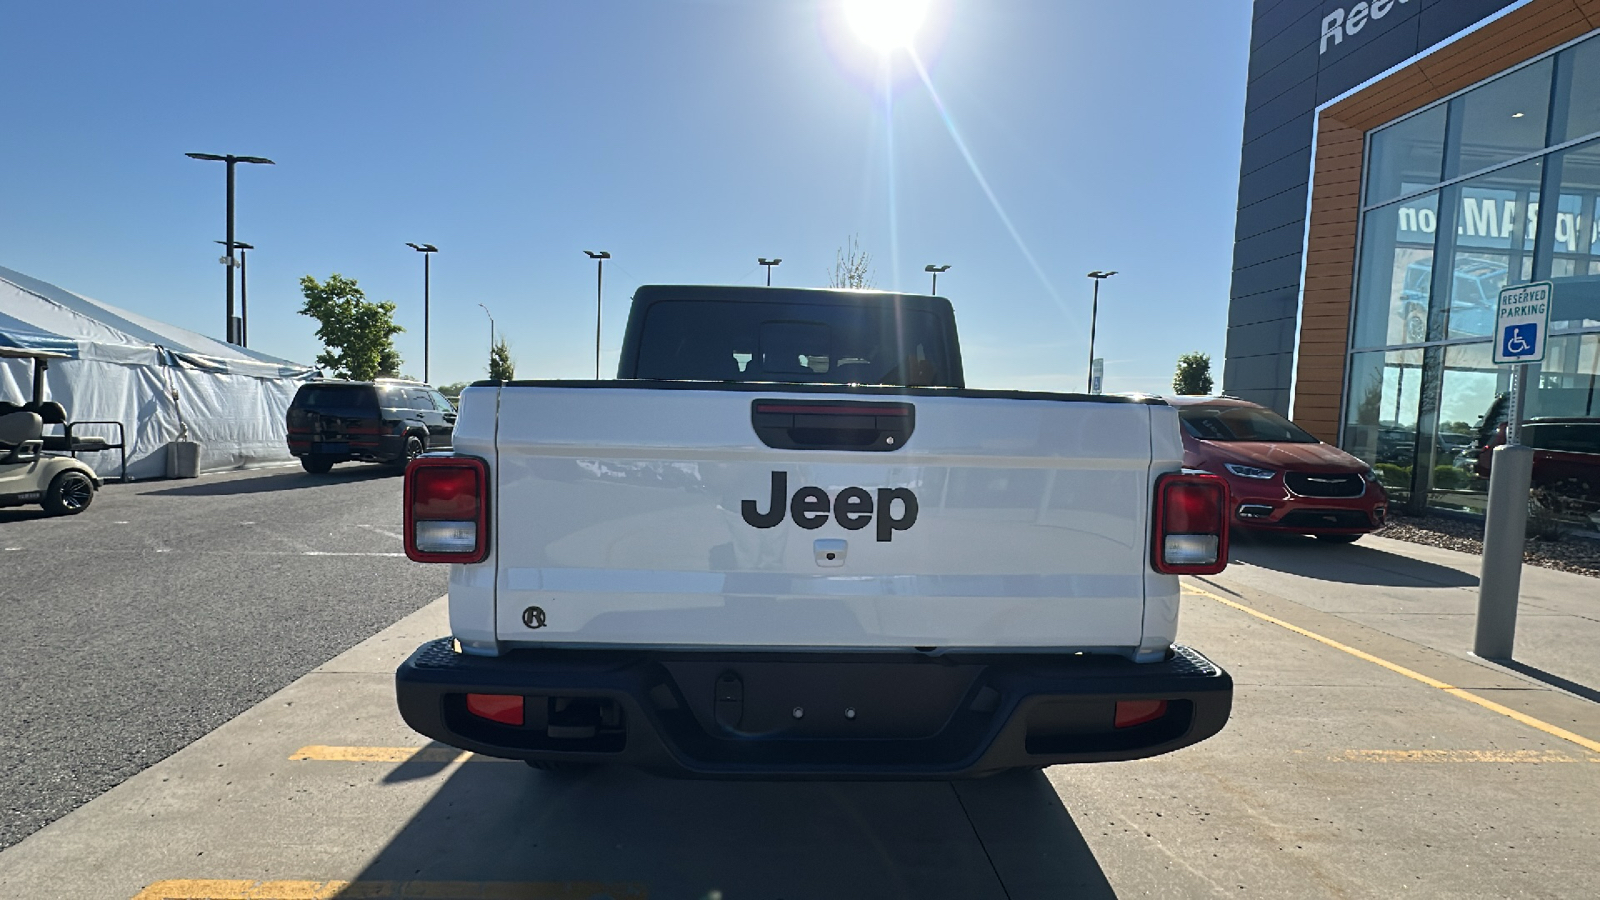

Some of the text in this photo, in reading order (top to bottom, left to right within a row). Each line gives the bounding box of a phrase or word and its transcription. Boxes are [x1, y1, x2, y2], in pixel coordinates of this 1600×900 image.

[1319, 0, 1408, 55] Ree
[1500, 303, 1546, 318] PARKING
[1502, 289, 1546, 305] RESERVED
[741, 471, 918, 542] Jeep
